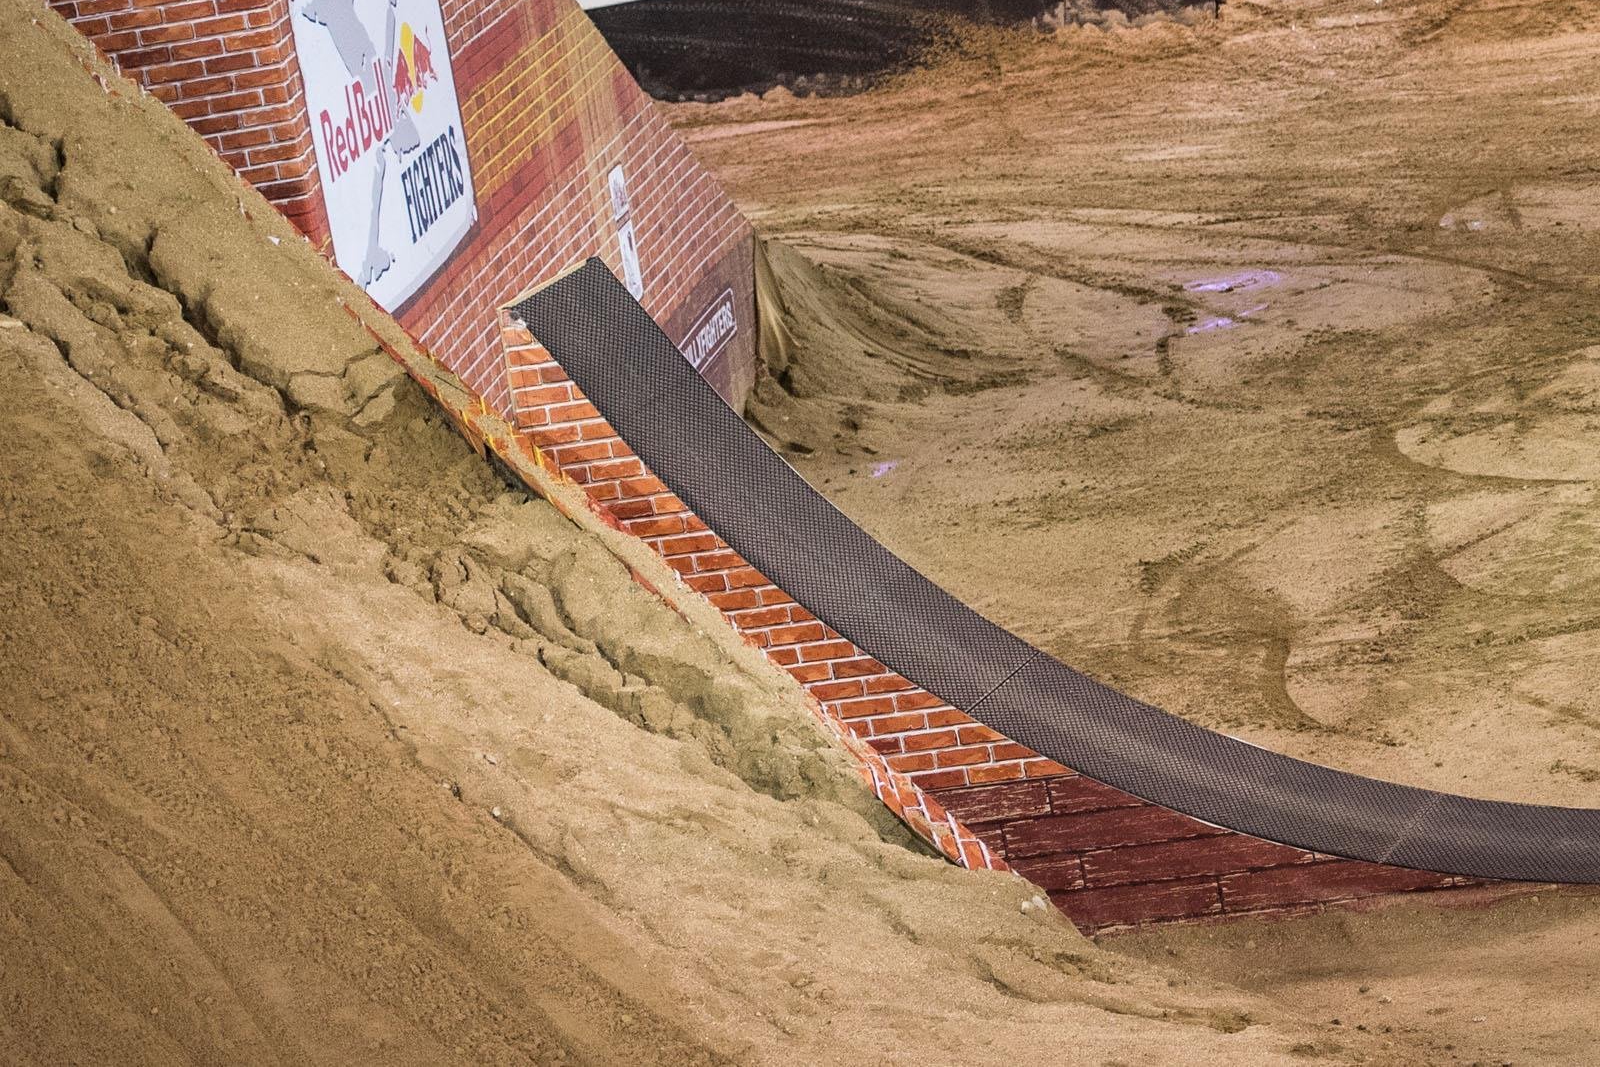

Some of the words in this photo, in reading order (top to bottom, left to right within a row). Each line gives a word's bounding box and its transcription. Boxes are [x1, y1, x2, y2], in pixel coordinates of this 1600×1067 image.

[320, 85, 361, 183] Red
[352, 58, 393, 153] Bull
[401, 125, 464, 244] FIGHTERS
